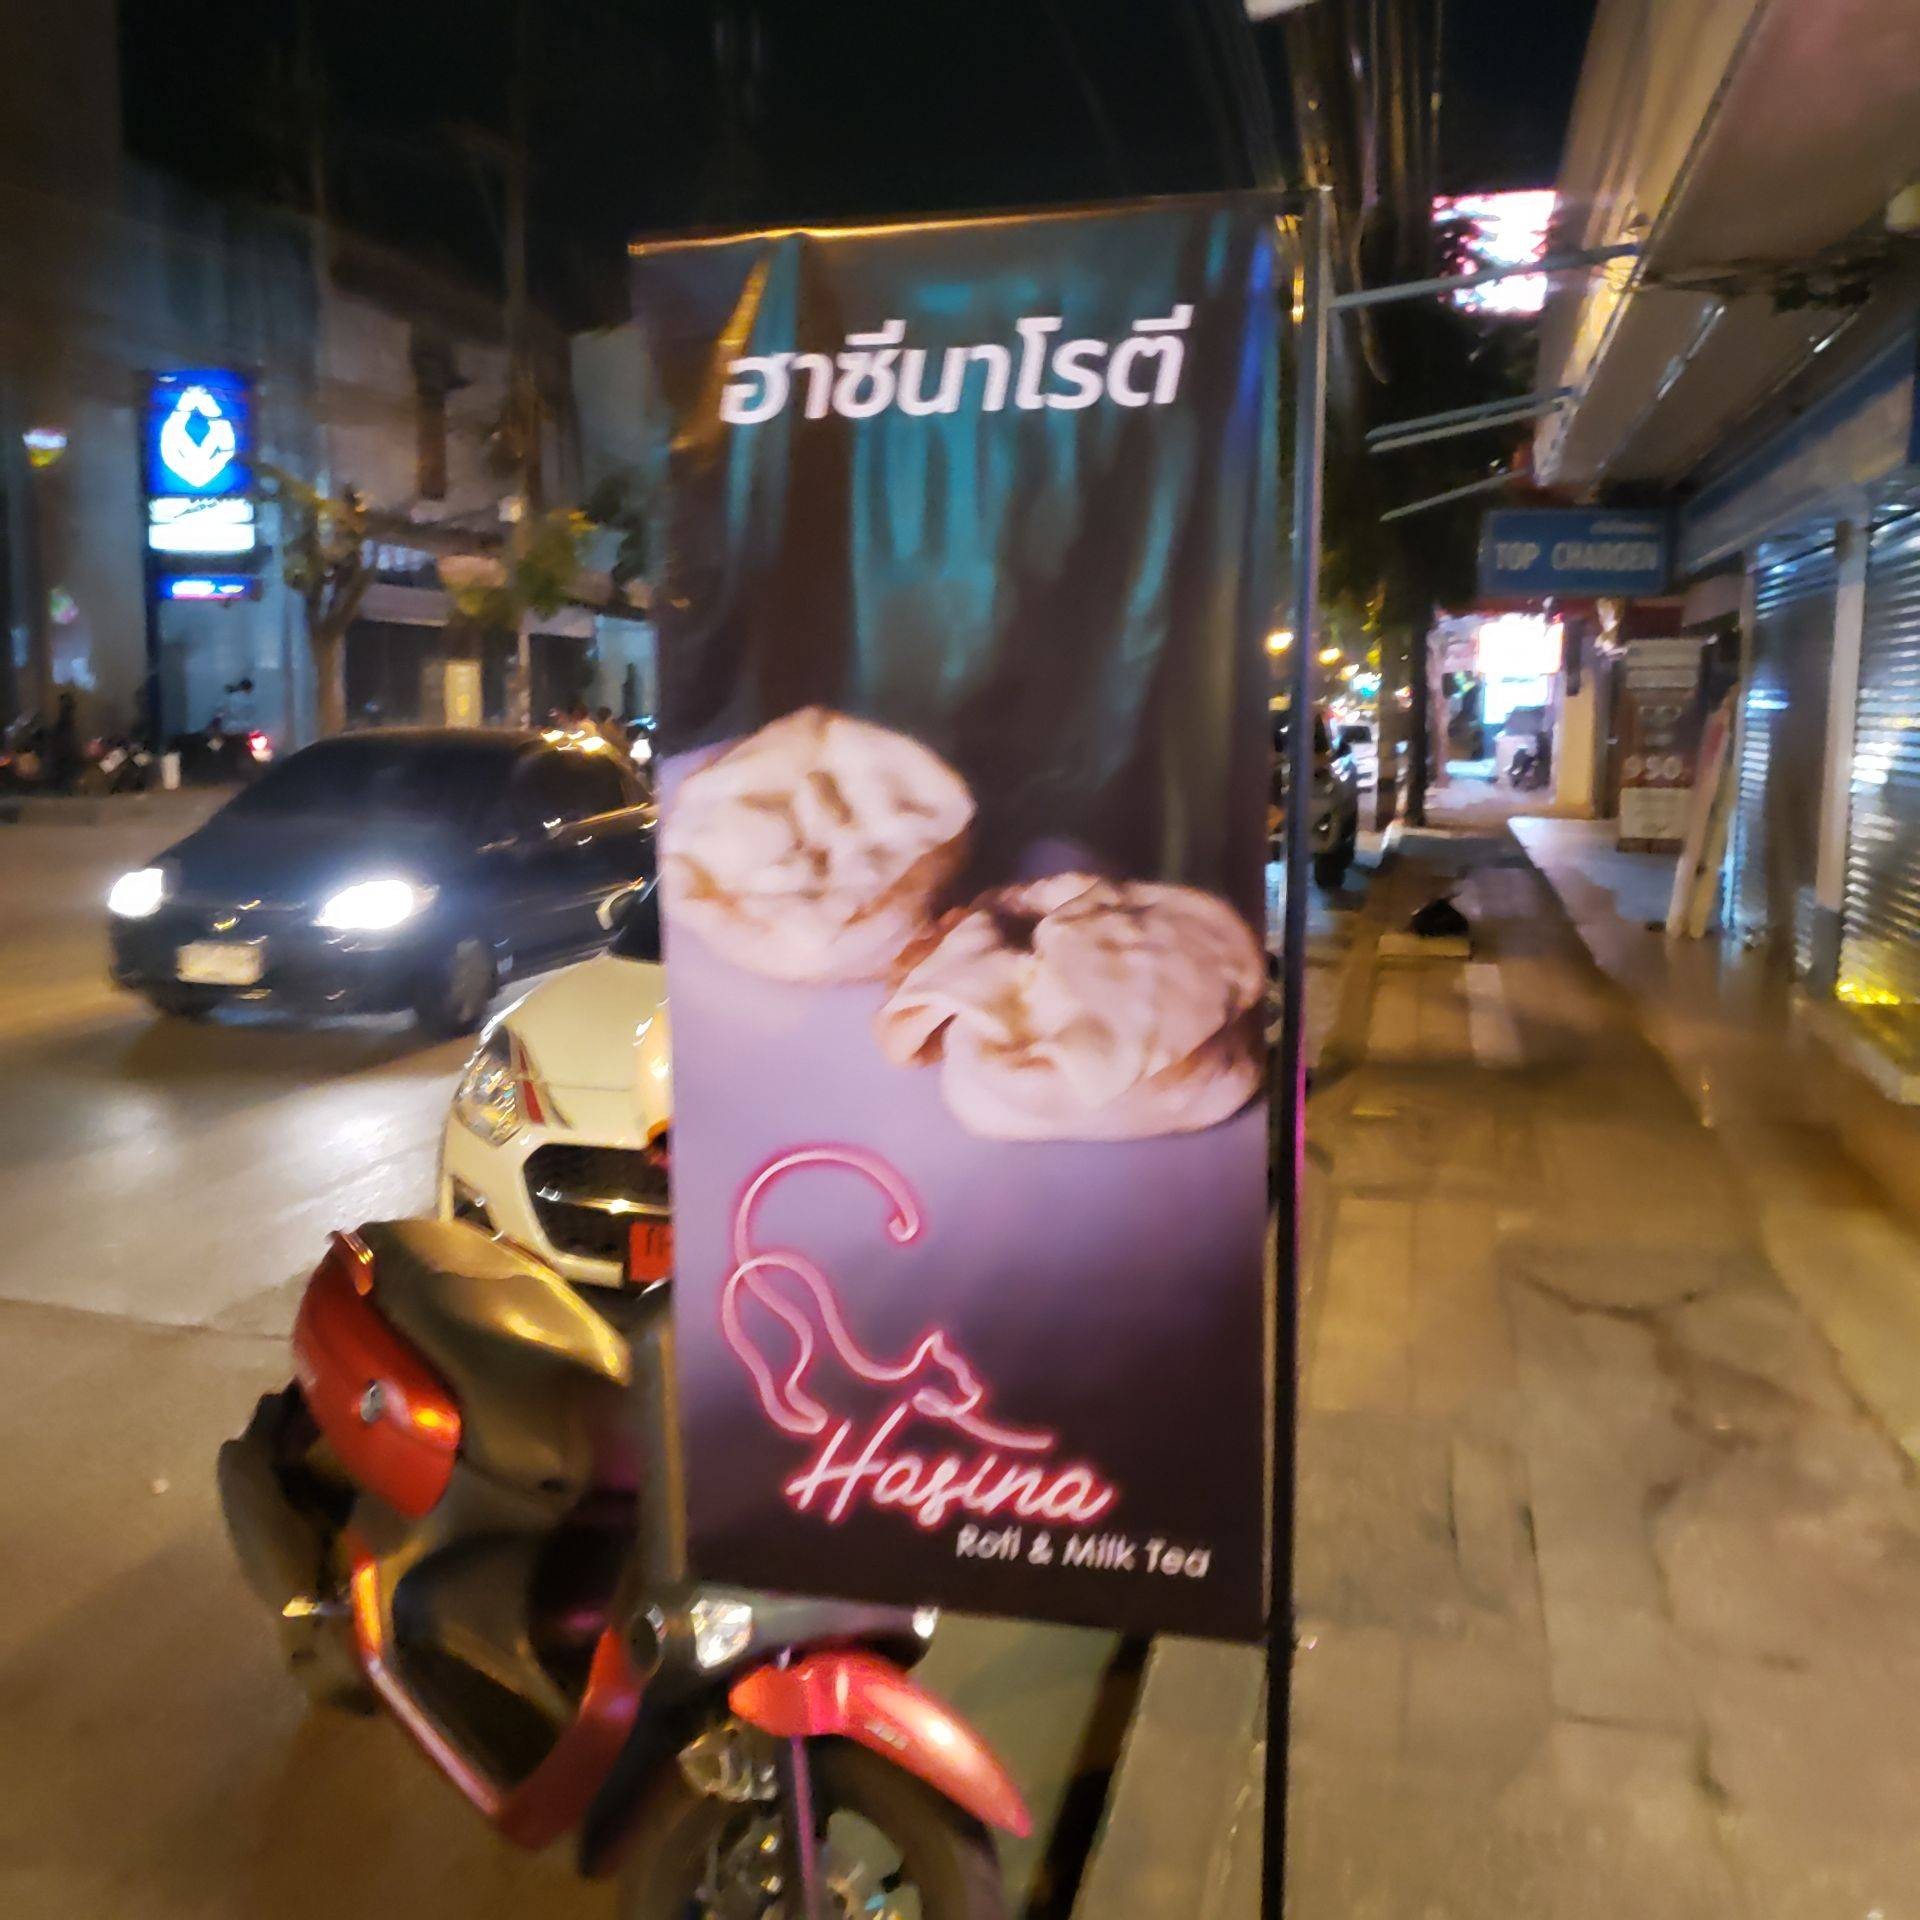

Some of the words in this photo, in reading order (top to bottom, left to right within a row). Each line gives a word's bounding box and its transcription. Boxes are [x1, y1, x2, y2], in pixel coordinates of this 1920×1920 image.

[719, 304, 1195, 425] ฮาซีนาโรตี
[1495, 541, 1540, 571] TOP
[784, 1401, 1114, 1526] Hasina
[1026, 1530, 1054, 1566] &
[1061, 1532, 1138, 1571] Milk
[1144, 1536, 1212, 1578] Tea
